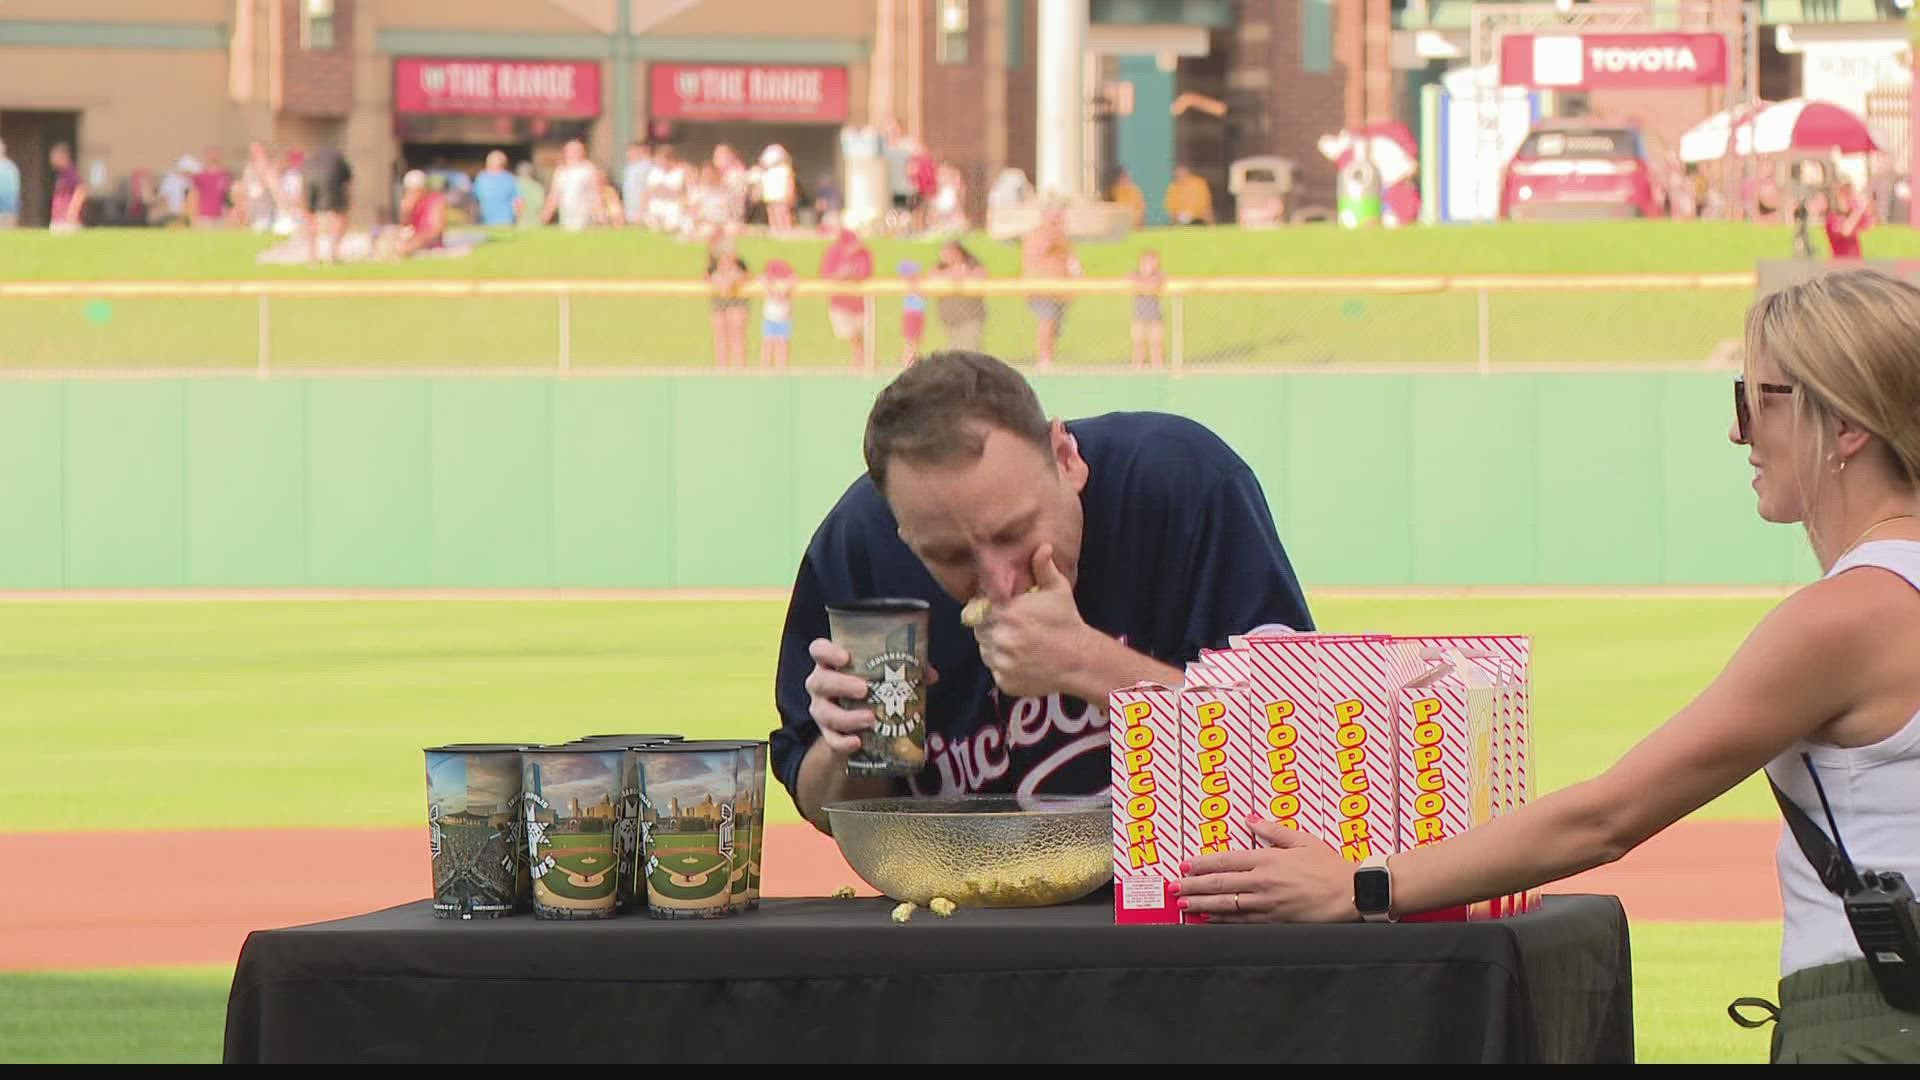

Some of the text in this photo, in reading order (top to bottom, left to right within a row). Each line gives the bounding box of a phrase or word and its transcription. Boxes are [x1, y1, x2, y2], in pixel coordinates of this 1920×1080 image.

[446, 64, 576, 98] THE RANGE
[700, 68, 823, 102] THE RANGE
[1590, 46, 1697, 72] TOYOTA
[1122, 700, 1160, 870] POPCORN
[1264, 699, 1301, 831] POPCO
[1411, 697, 1448, 848] POPCOR
